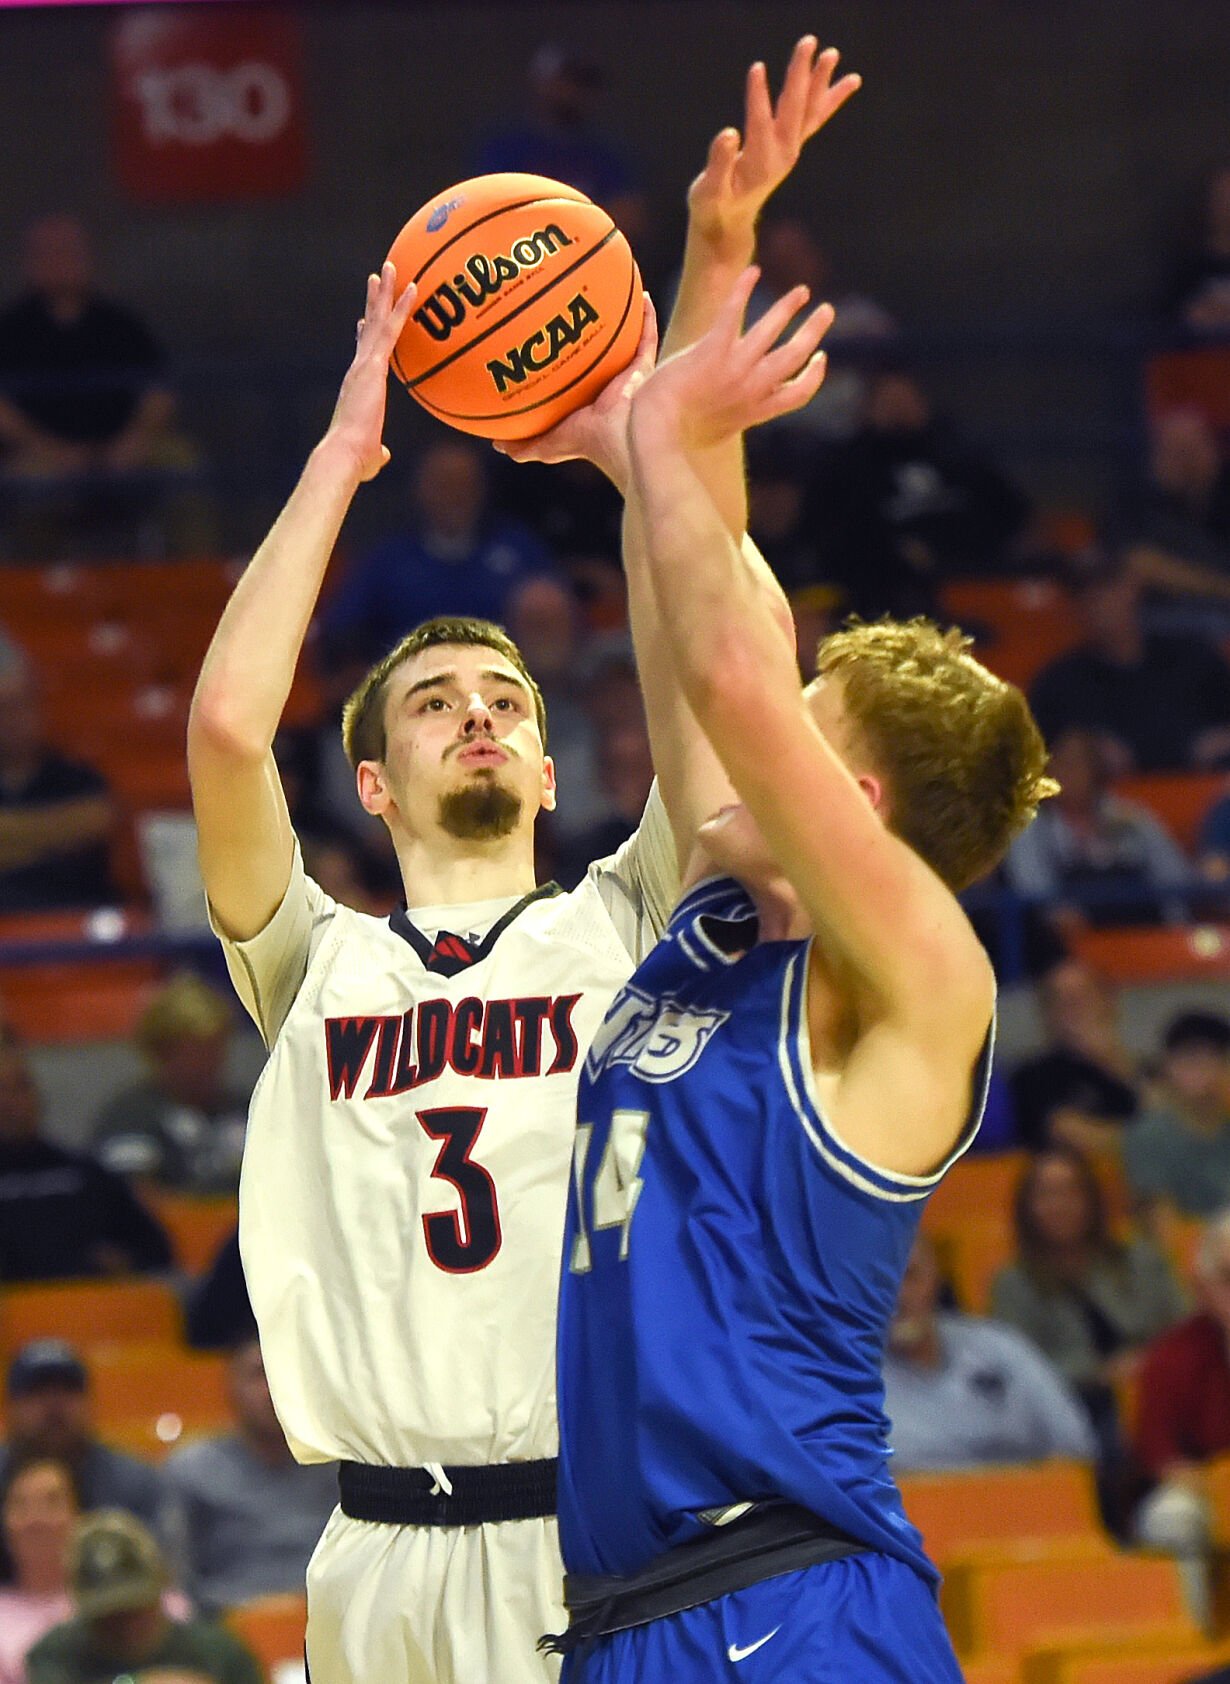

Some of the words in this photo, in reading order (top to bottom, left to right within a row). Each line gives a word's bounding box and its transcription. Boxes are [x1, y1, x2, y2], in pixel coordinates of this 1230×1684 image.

[135, 61, 291, 145] 130
[412, 223, 573, 342] Wilson
[486, 292, 600, 393] NCAA
[324, 992, 584, 1102] WILDCATS
[414, 1105, 503, 1275] 3
[568, 1108, 652, 1275] 14
